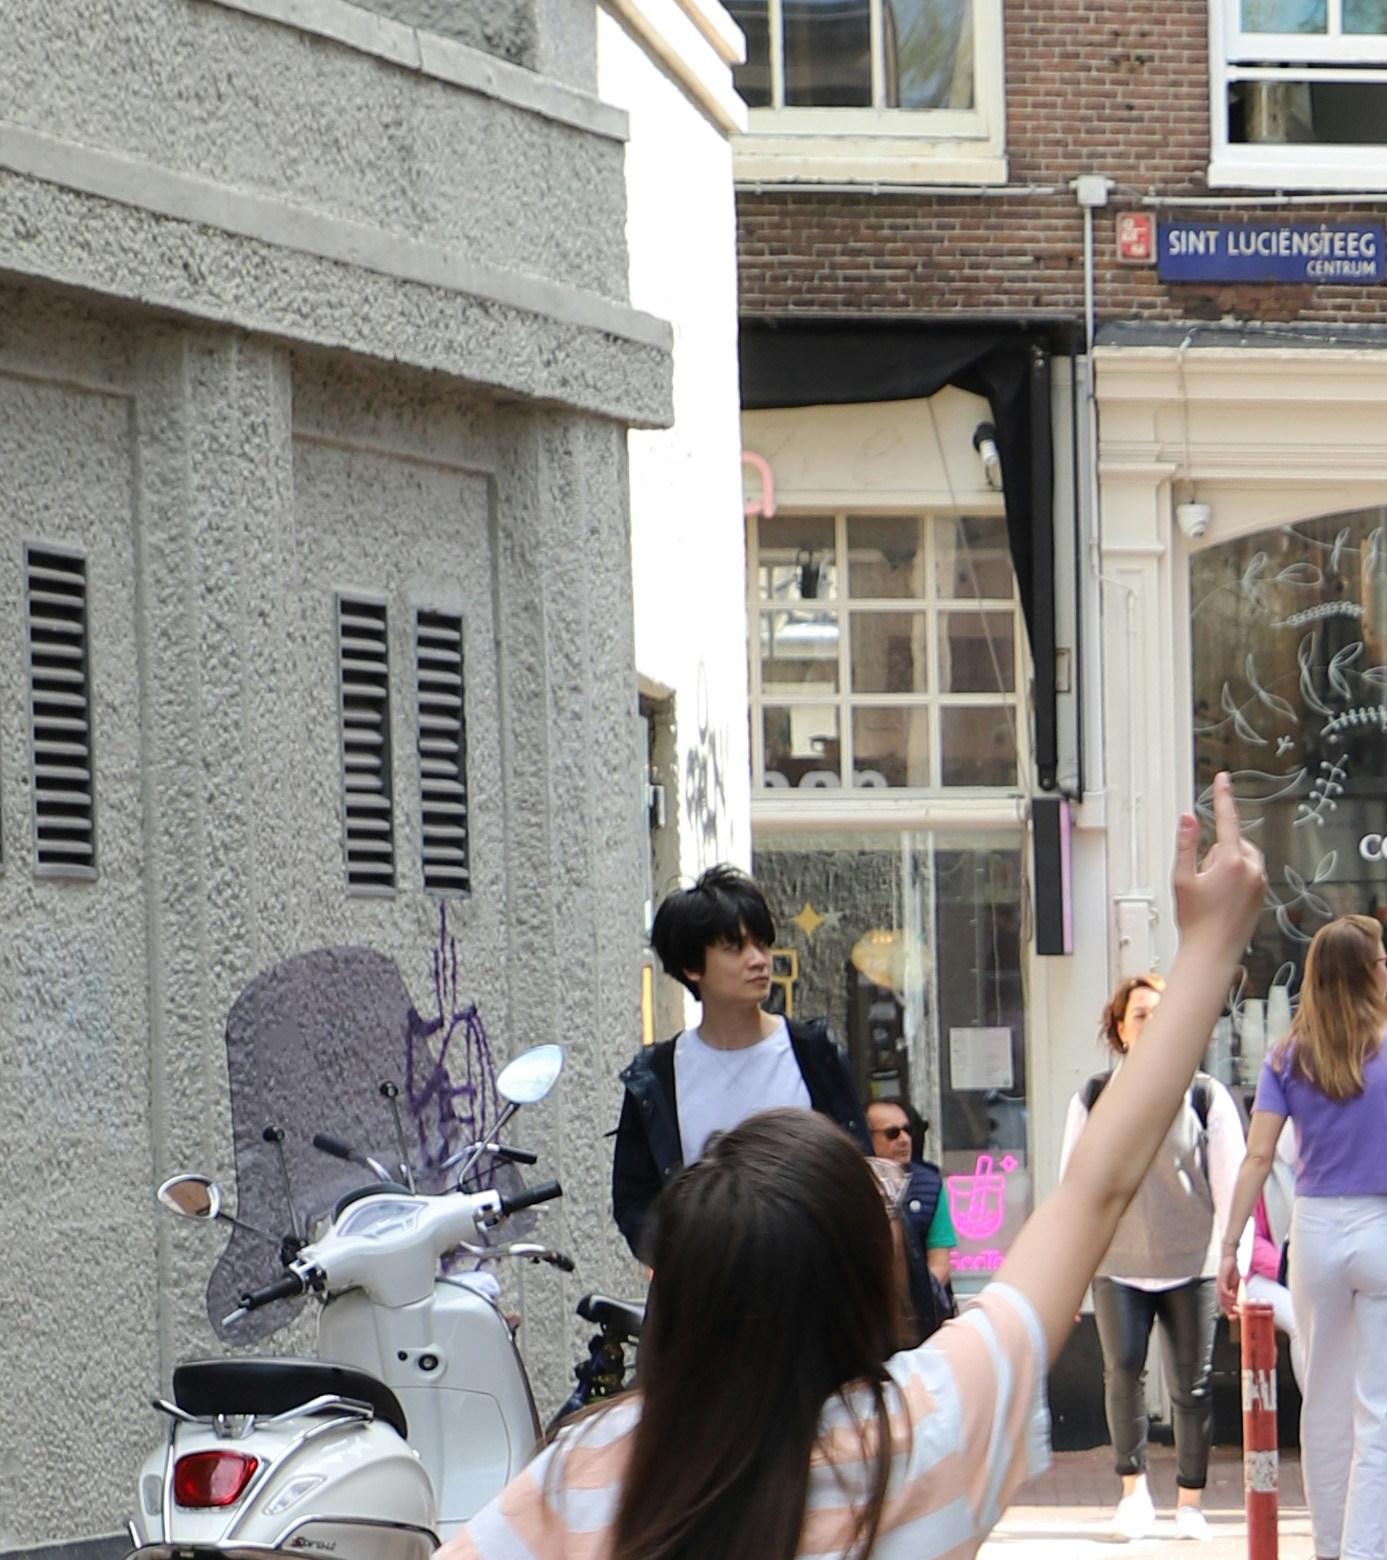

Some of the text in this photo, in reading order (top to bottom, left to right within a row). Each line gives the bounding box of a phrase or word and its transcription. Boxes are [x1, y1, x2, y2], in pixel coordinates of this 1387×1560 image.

[1168, 229, 1219, 256] SINT
[1227, 227, 1377, 257] LUCIËNSTEEG
[1306, 259, 1377, 278] CENTRUM
